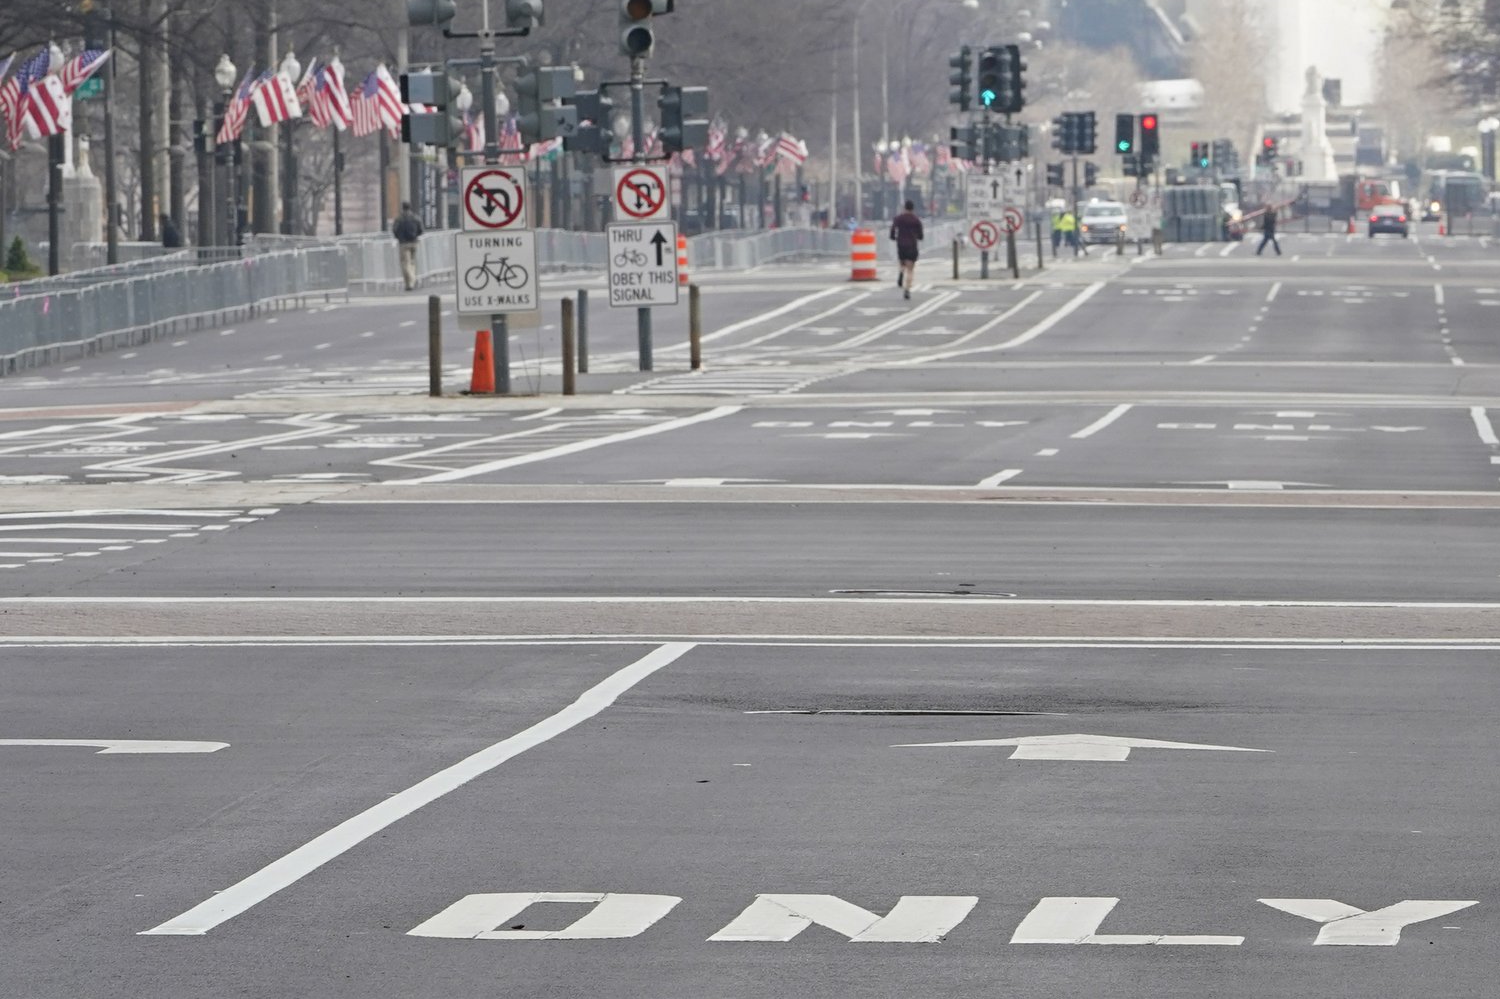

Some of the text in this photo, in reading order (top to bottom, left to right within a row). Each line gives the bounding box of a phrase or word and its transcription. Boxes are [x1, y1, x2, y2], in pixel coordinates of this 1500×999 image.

[612, 229, 642, 242] THRU
[469, 237, 523, 249] TURNING
[612, 270, 674, 286] OBEY THIS
[465, 294, 530, 307] USE X-WALKS
[613, 287, 654, 302] SIGNAL
[404, 892, 1480, 946] ONLY
